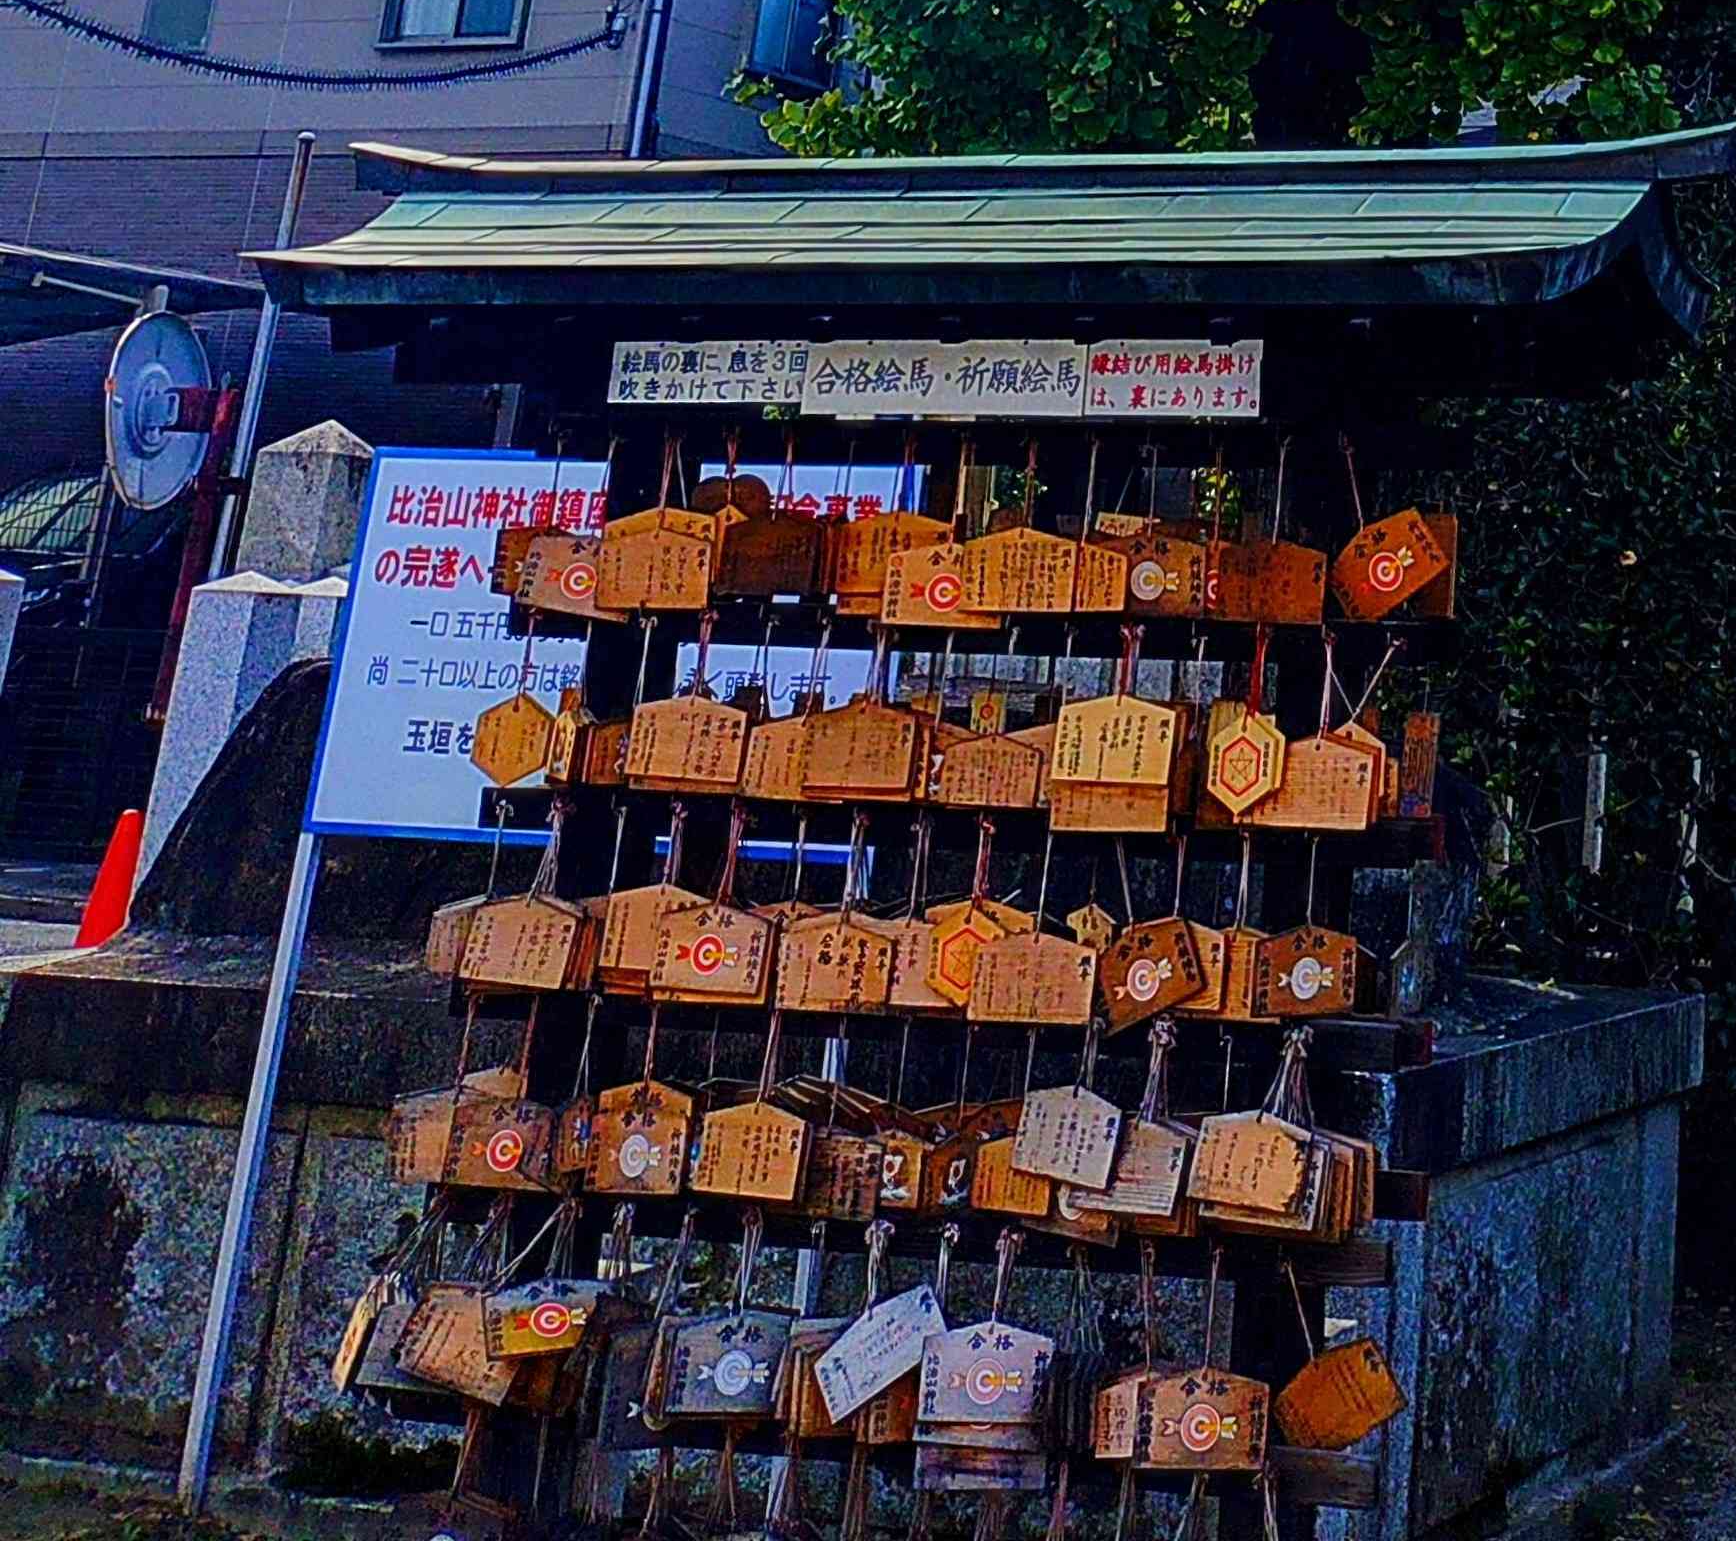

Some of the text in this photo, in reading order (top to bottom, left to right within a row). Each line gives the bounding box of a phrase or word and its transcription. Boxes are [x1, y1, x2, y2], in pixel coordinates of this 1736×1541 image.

[1090, 351, 1255, 376] 縁結び用絵馬掛け
[618, 377, 804, 401] 吹きかけて下さい
[810, 356, 1082, 398] 合格絵馬・祈願絵馬
[1090, 387, 1258, 410] は、裏にあります。
[386, 484, 608, 531] 比治山神社御鎮座
